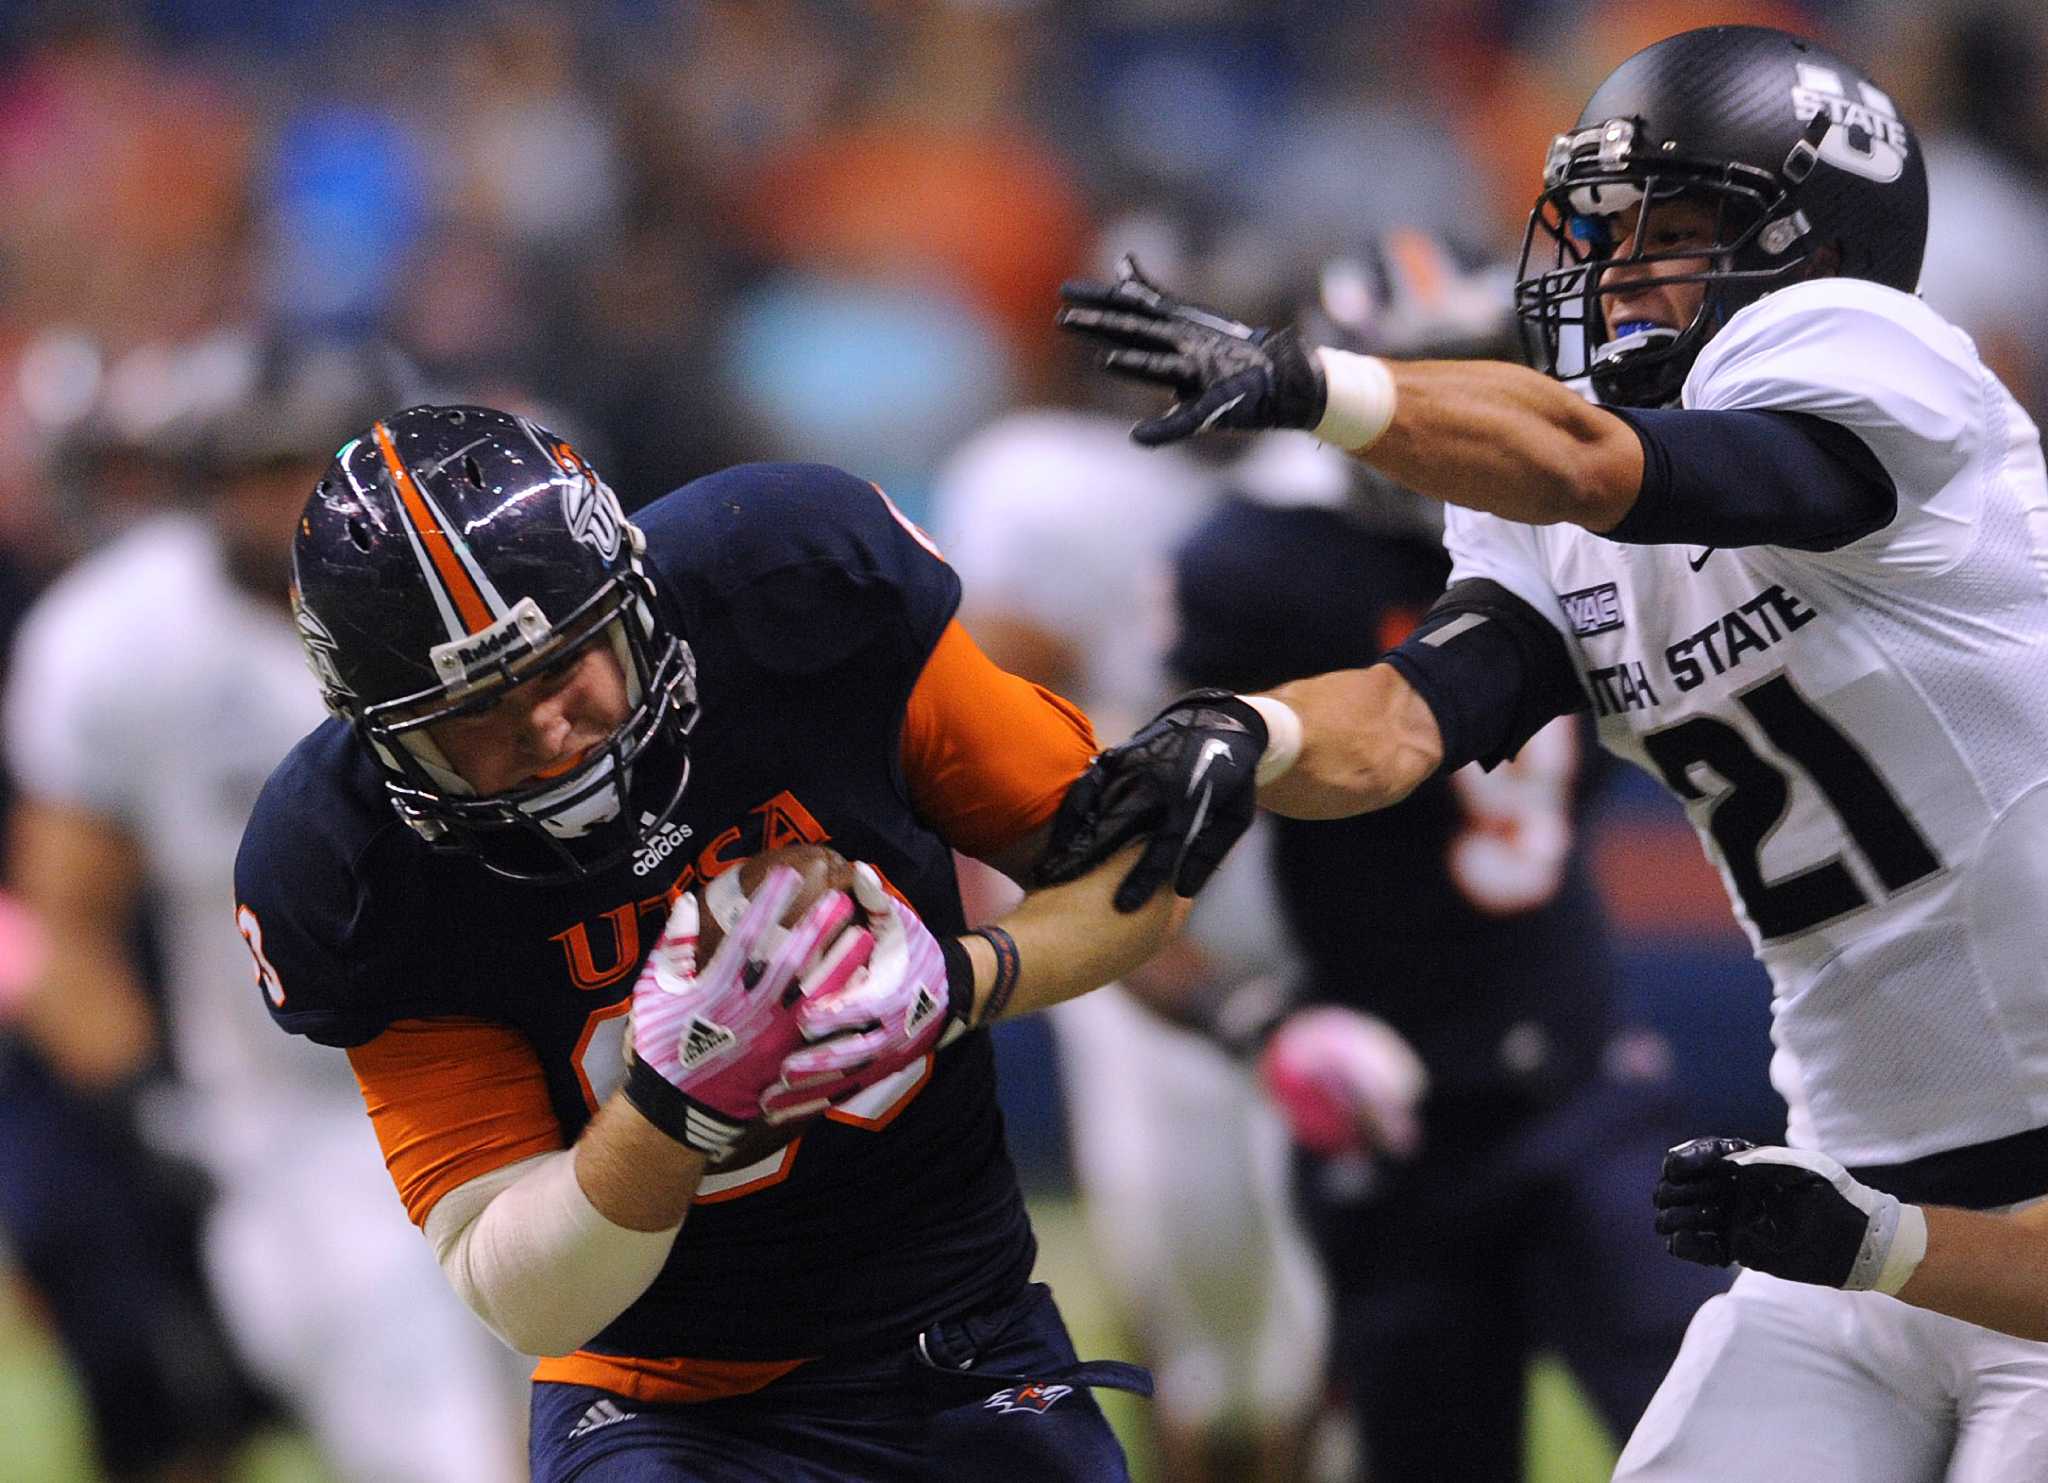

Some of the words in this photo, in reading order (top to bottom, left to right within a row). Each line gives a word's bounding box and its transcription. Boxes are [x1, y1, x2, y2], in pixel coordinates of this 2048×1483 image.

[1791, 86, 1909, 161] STATE
[1665, 584, 1819, 692] STATE
[1639, 665, 1946, 942] 21
[632, 823, 694, 876] adidas
